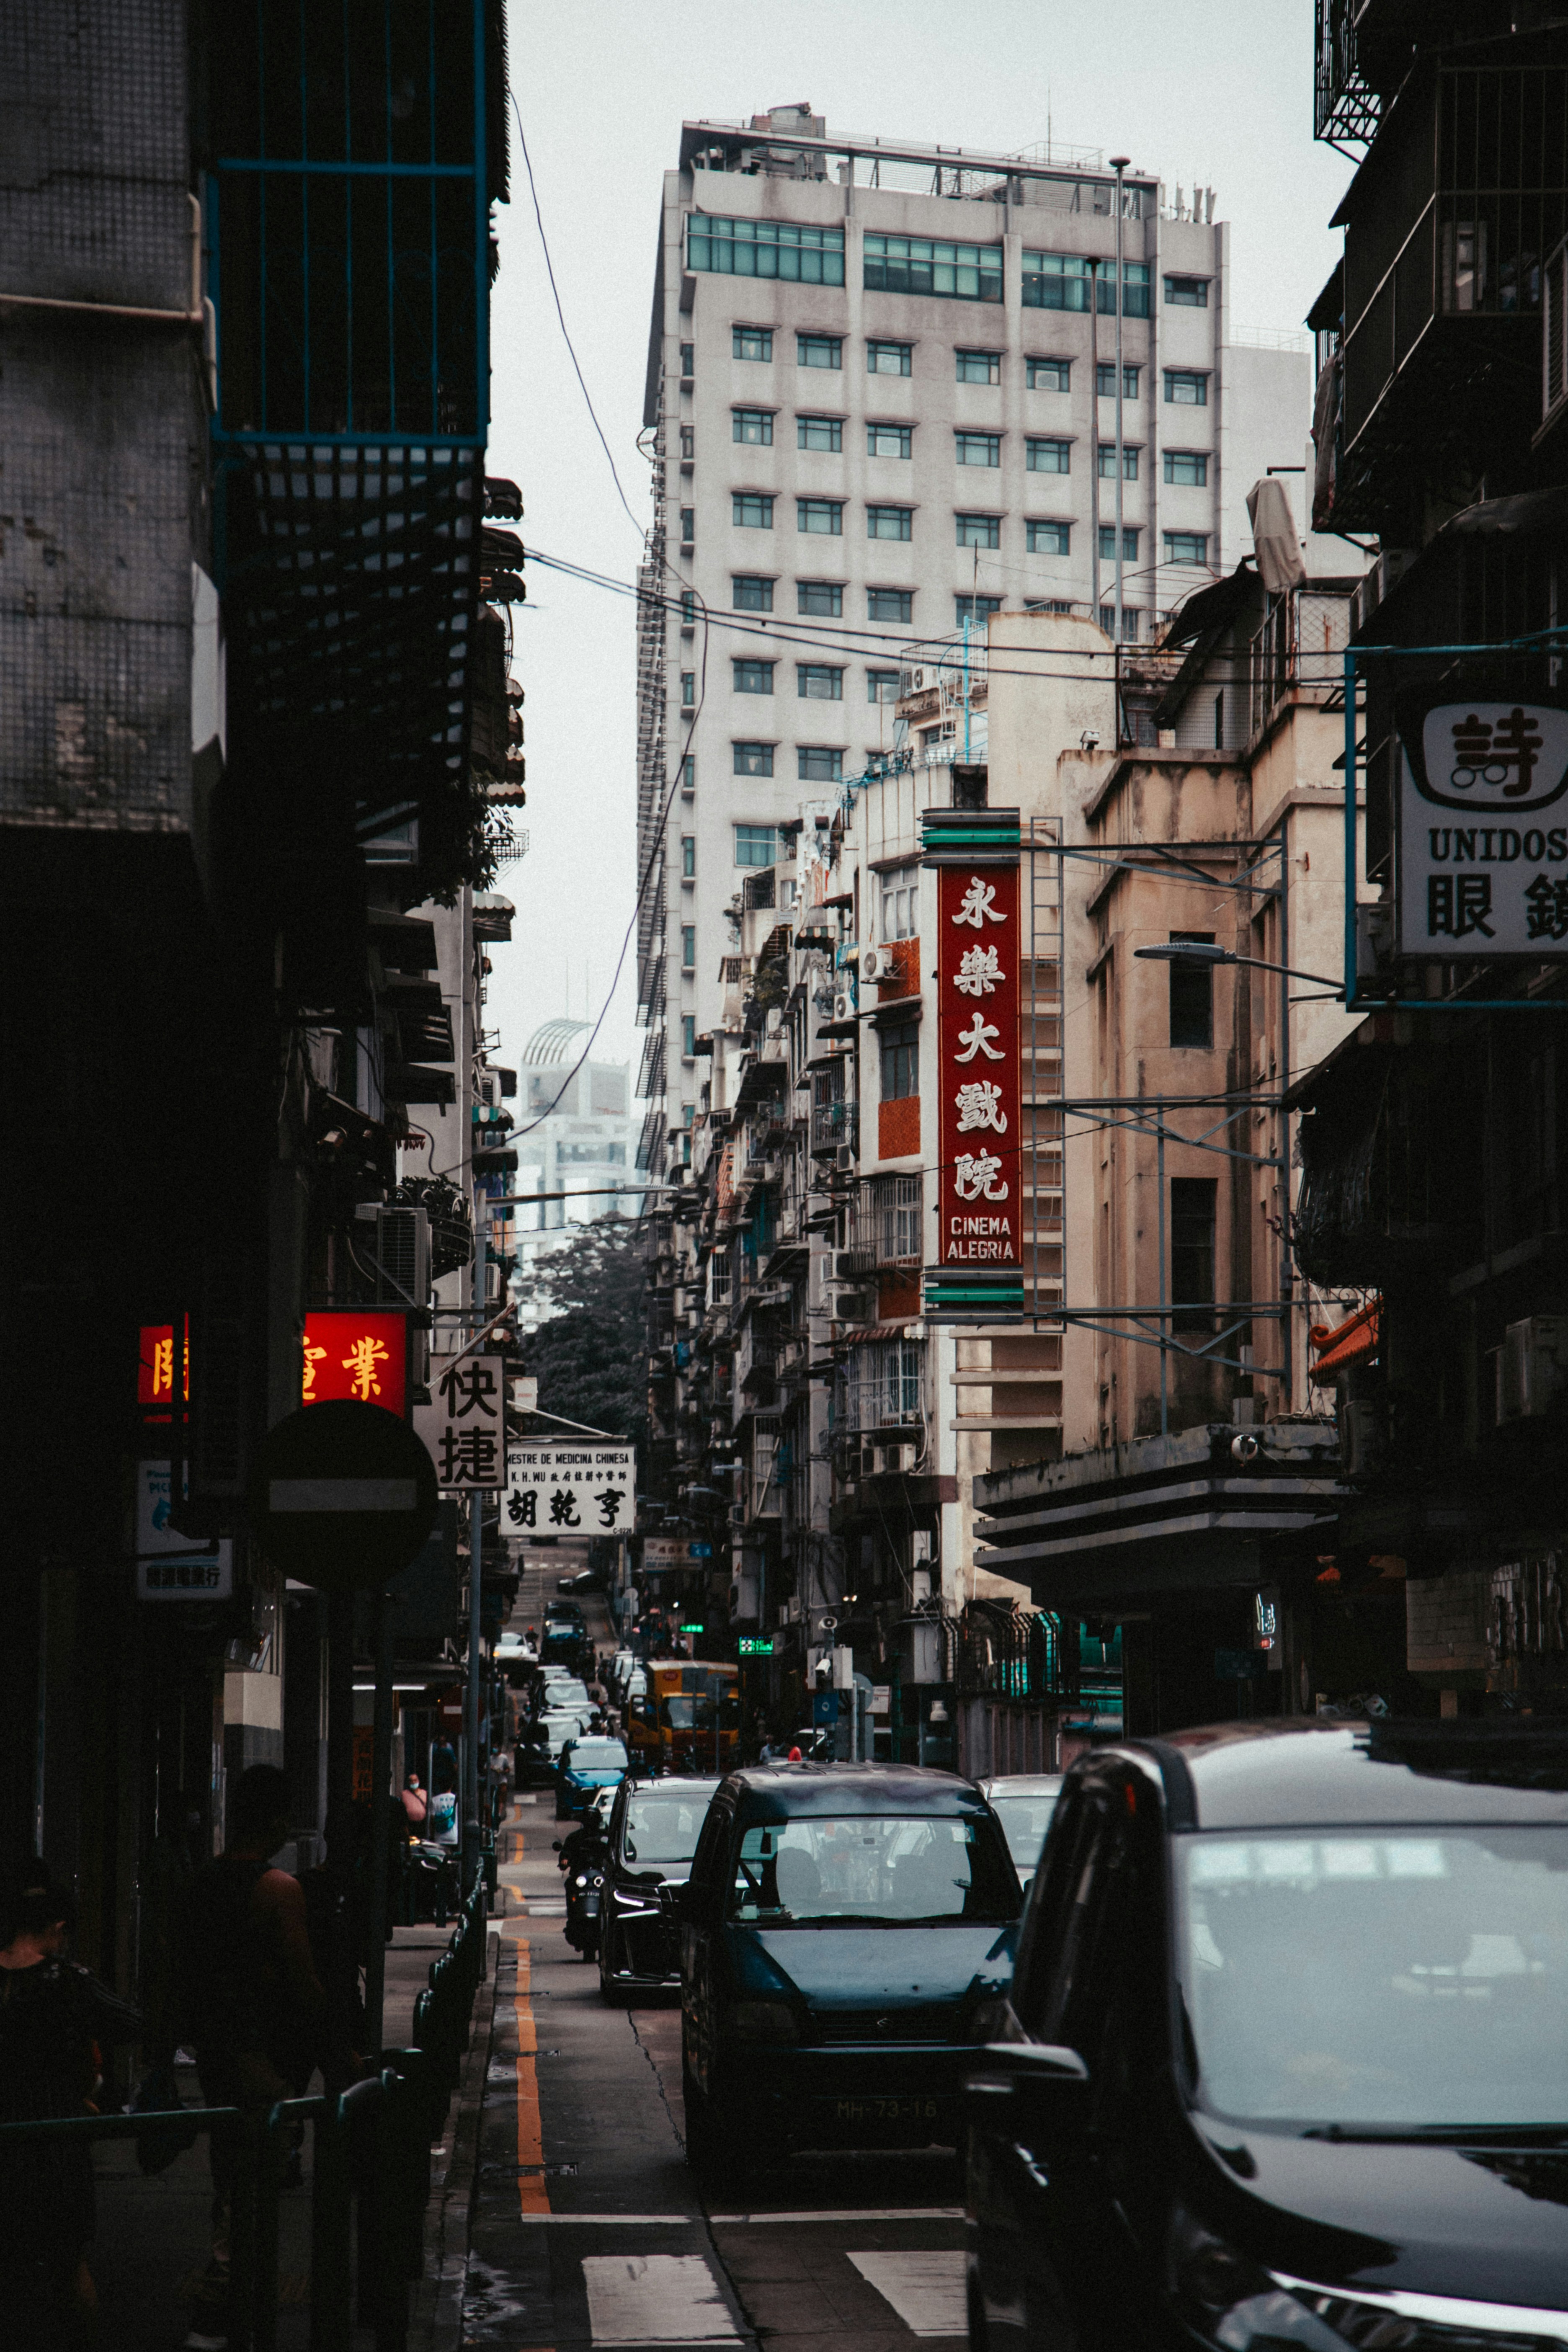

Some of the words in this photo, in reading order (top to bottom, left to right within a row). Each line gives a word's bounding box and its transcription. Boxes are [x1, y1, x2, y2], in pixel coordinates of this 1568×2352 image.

[1452, 707, 1543, 797] 詩
[1429, 828, 1568, 861] UNIDOS
[952, 876, 1008, 1201] 永樂大戲院
[951, 1217, 1011, 1235] CINEMA
[947, 1240, 1014, 1259] ALEGRIA
[438, 1361, 498, 1483] 快捷
[507, 1454, 537, 1464] MESTRE
[541, 1454, 551, 1464] DE
[556, 1453, 592, 1464] MEDICINA
[596, 1453, 629, 1464] CHINESA
